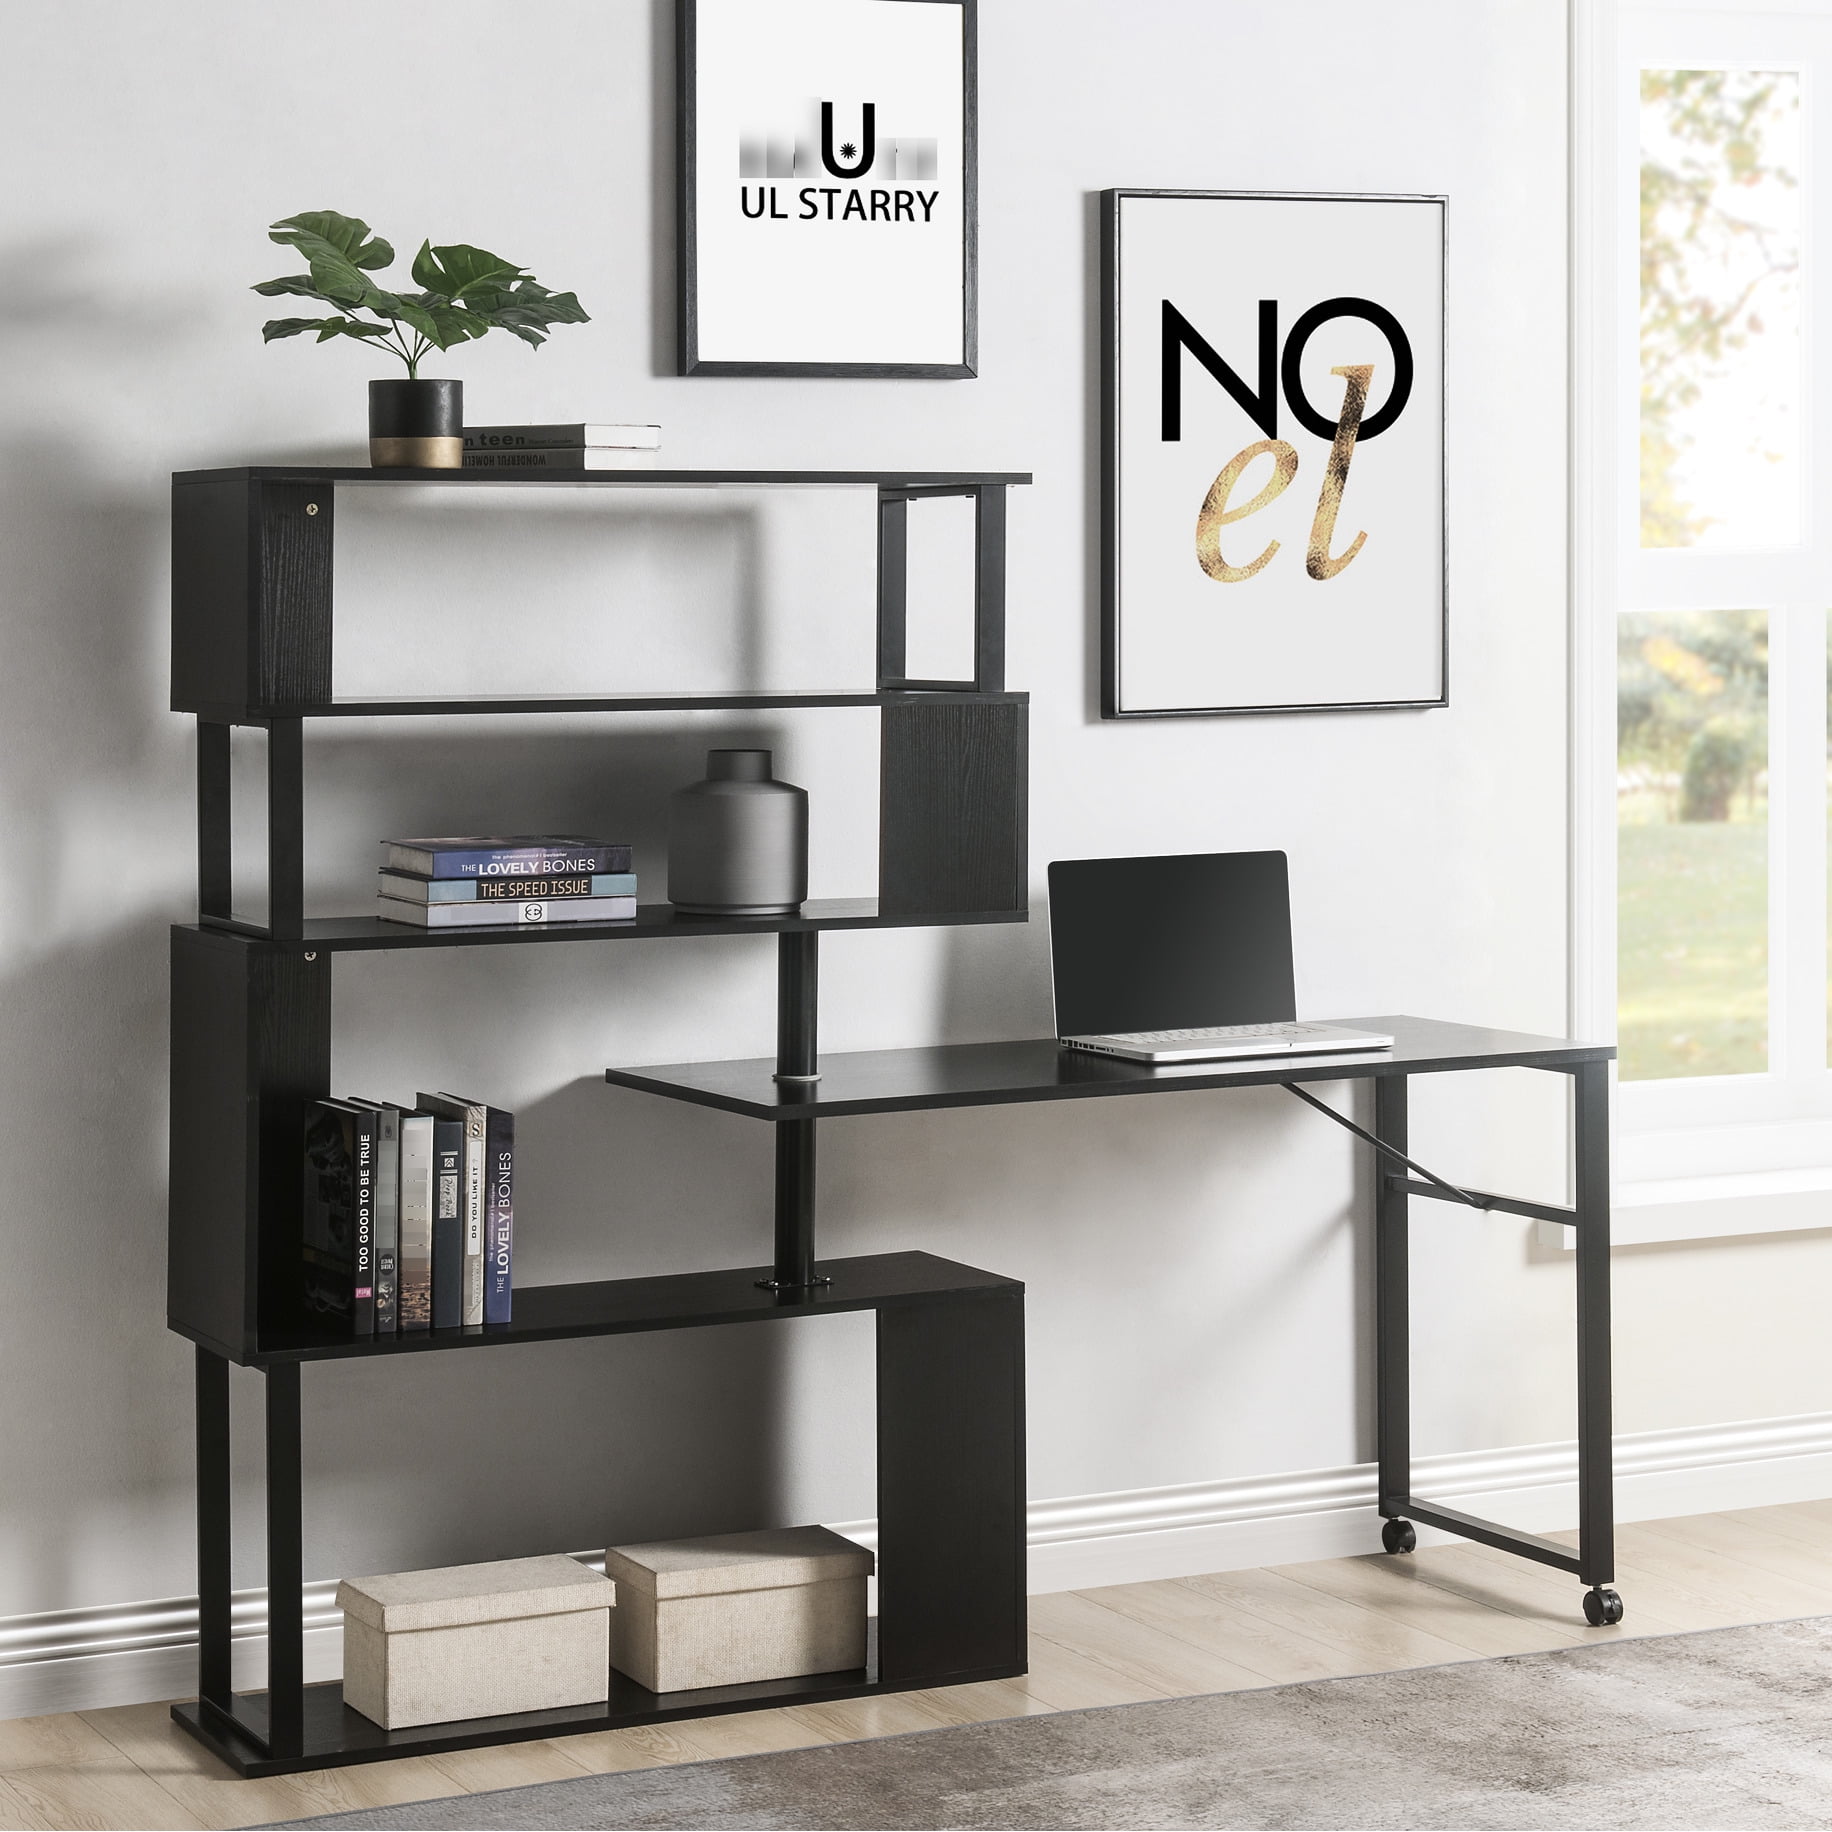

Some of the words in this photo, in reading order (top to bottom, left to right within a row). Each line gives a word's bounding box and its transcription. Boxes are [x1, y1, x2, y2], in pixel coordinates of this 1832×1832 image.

[741, 186, 789, 219] UL
[798, 187, 940, 222] STARRY
[1161, 297, 1414, 442] NO
[480, 433, 526, 446] teen
[497, 455, 546, 466] WONDERFUL
[1195, 364, 1376, 583] el
[461, 864, 477, 872] THE
[478, 861, 540, 876] LOVELY
[543, 858, 596, 873] BONES
[481, 883, 506, 897] THE
[509, 881, 548, 897] SPEED
[551, 879, 589, 895] ISSUE
[471, 1123, 480, 1137] S
[360, 1134, 370, 1165] TRUE
[360, 1167, 370, 1185] BE
[472, 1167, 478, 1177] IT
[499, 1152, 512, 1207] BONES
[360, 1189, 369, 1206] TO
[359, 1209, 369, 1244] GOOD
[471, 1225, 477, 1239] DO
[497, 1210, 510, 1275] LOVELY
[359, 1246, 369, 1272] TOO
[497, 1277, 505, 1293] THE
